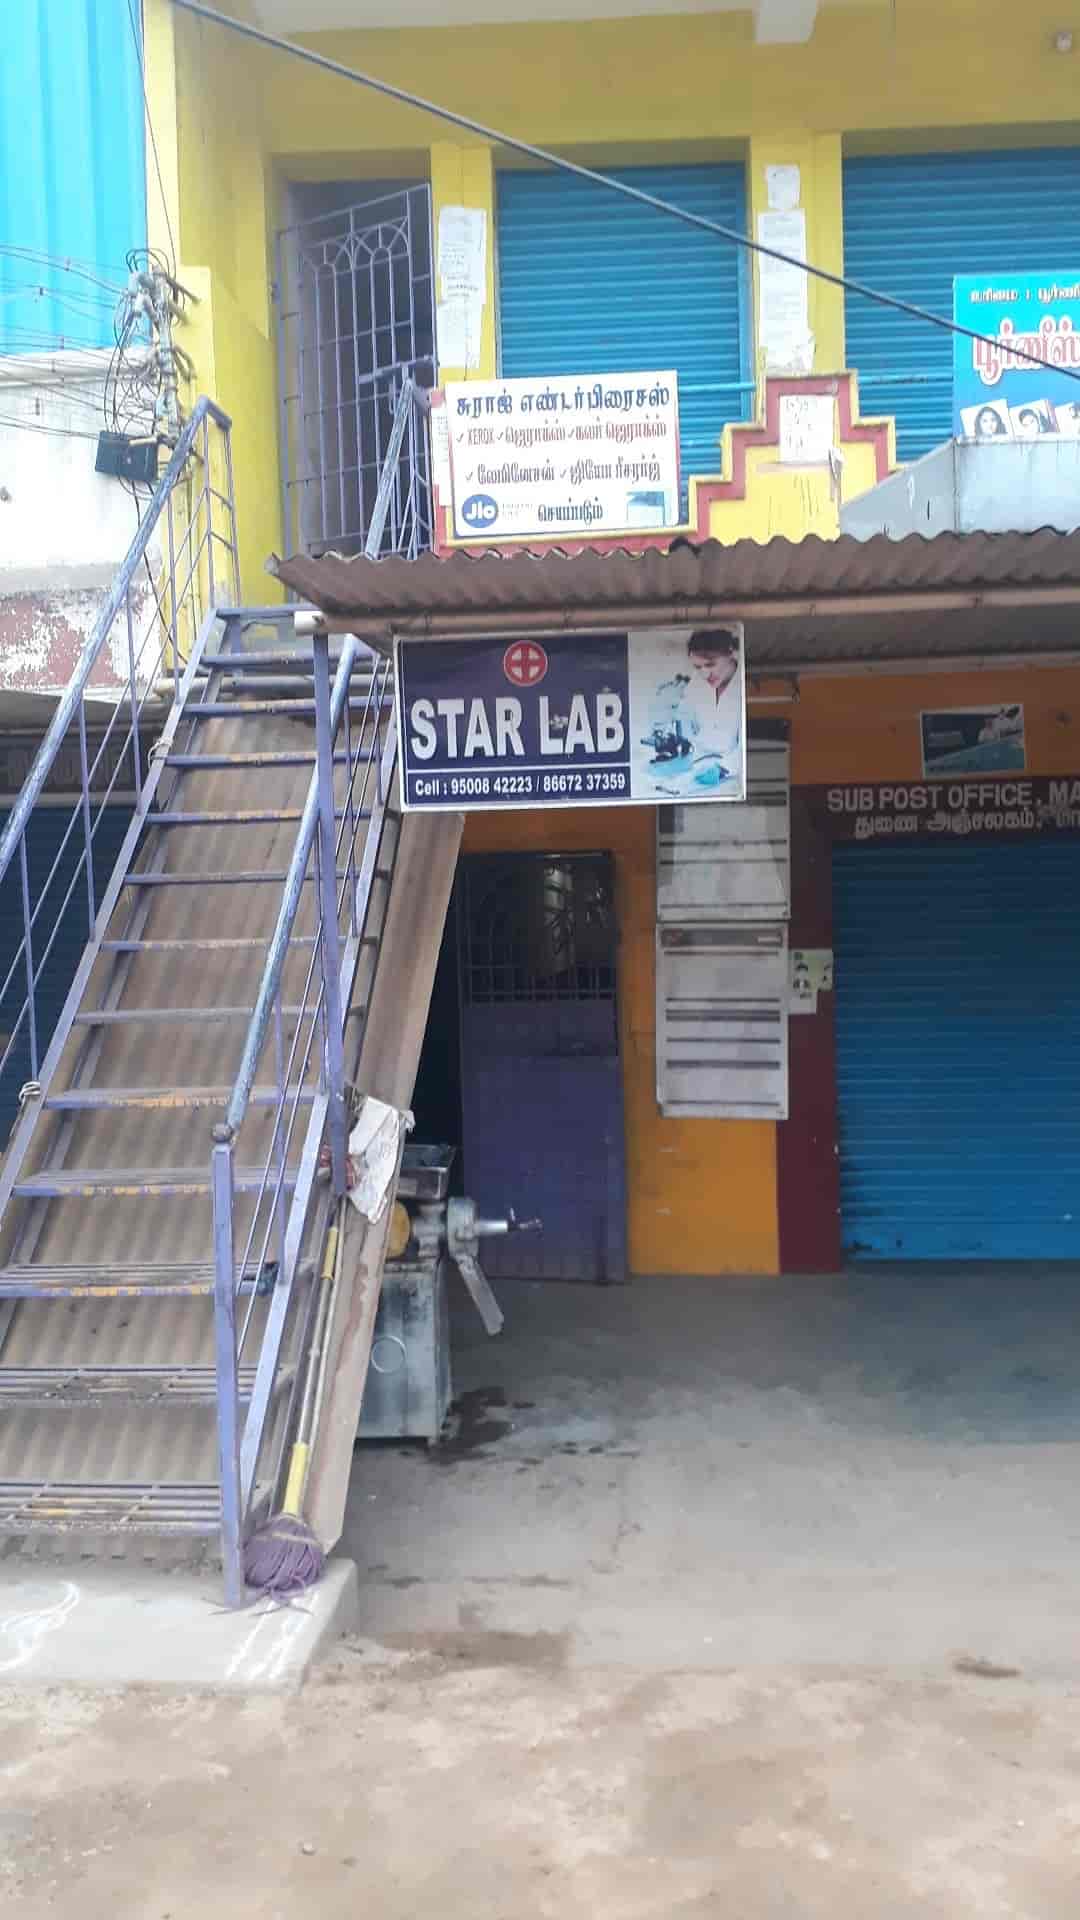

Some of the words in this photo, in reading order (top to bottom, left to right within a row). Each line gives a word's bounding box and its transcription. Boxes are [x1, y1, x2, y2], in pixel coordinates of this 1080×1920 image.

[456, 388, 513, 418] சுராஜ்
[520, 381, 670, 412] எண்டர்பிரைசஸ்
[410, 696, 525, 761] STAR
[539, 692, 625, 756] LAB
[415, 779, 440, 796] Cell
[451, 777, 490, 795] 95008
[493, 775, 533, 794] 42223
[543, 774, 582, 792] 86672
[586, 772, 626, 791] 37359
[827, 788, 874, 813] SUB
[879, 785, 944, 811] POST
